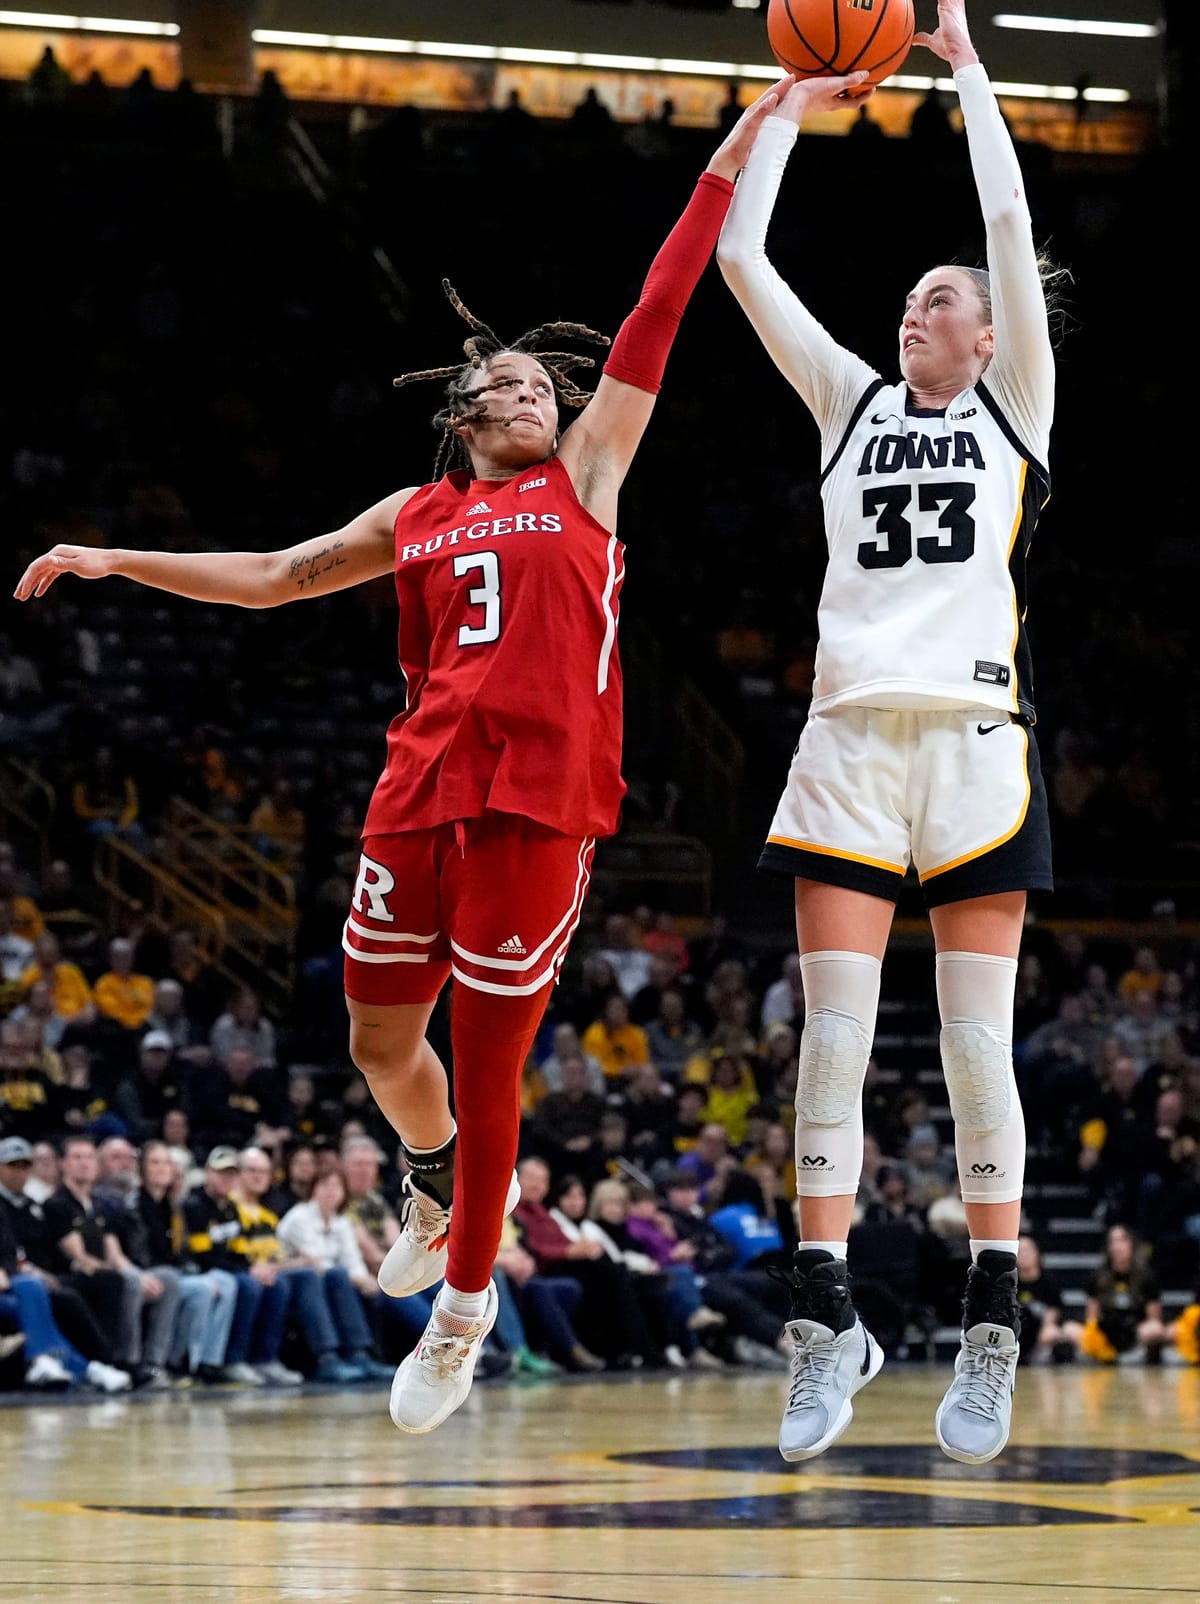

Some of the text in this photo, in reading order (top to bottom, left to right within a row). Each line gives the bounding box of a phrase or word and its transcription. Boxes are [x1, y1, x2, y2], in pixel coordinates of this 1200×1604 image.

[857, 431, 986, 476] IOWA
[401, 512, 563, 562] RUTGERS
[857, 481, 976, 569] 33
[453, 550, 502, 647] 3
[352, 852, 396, 923] R
[497, 946, 527, 954] adidas
